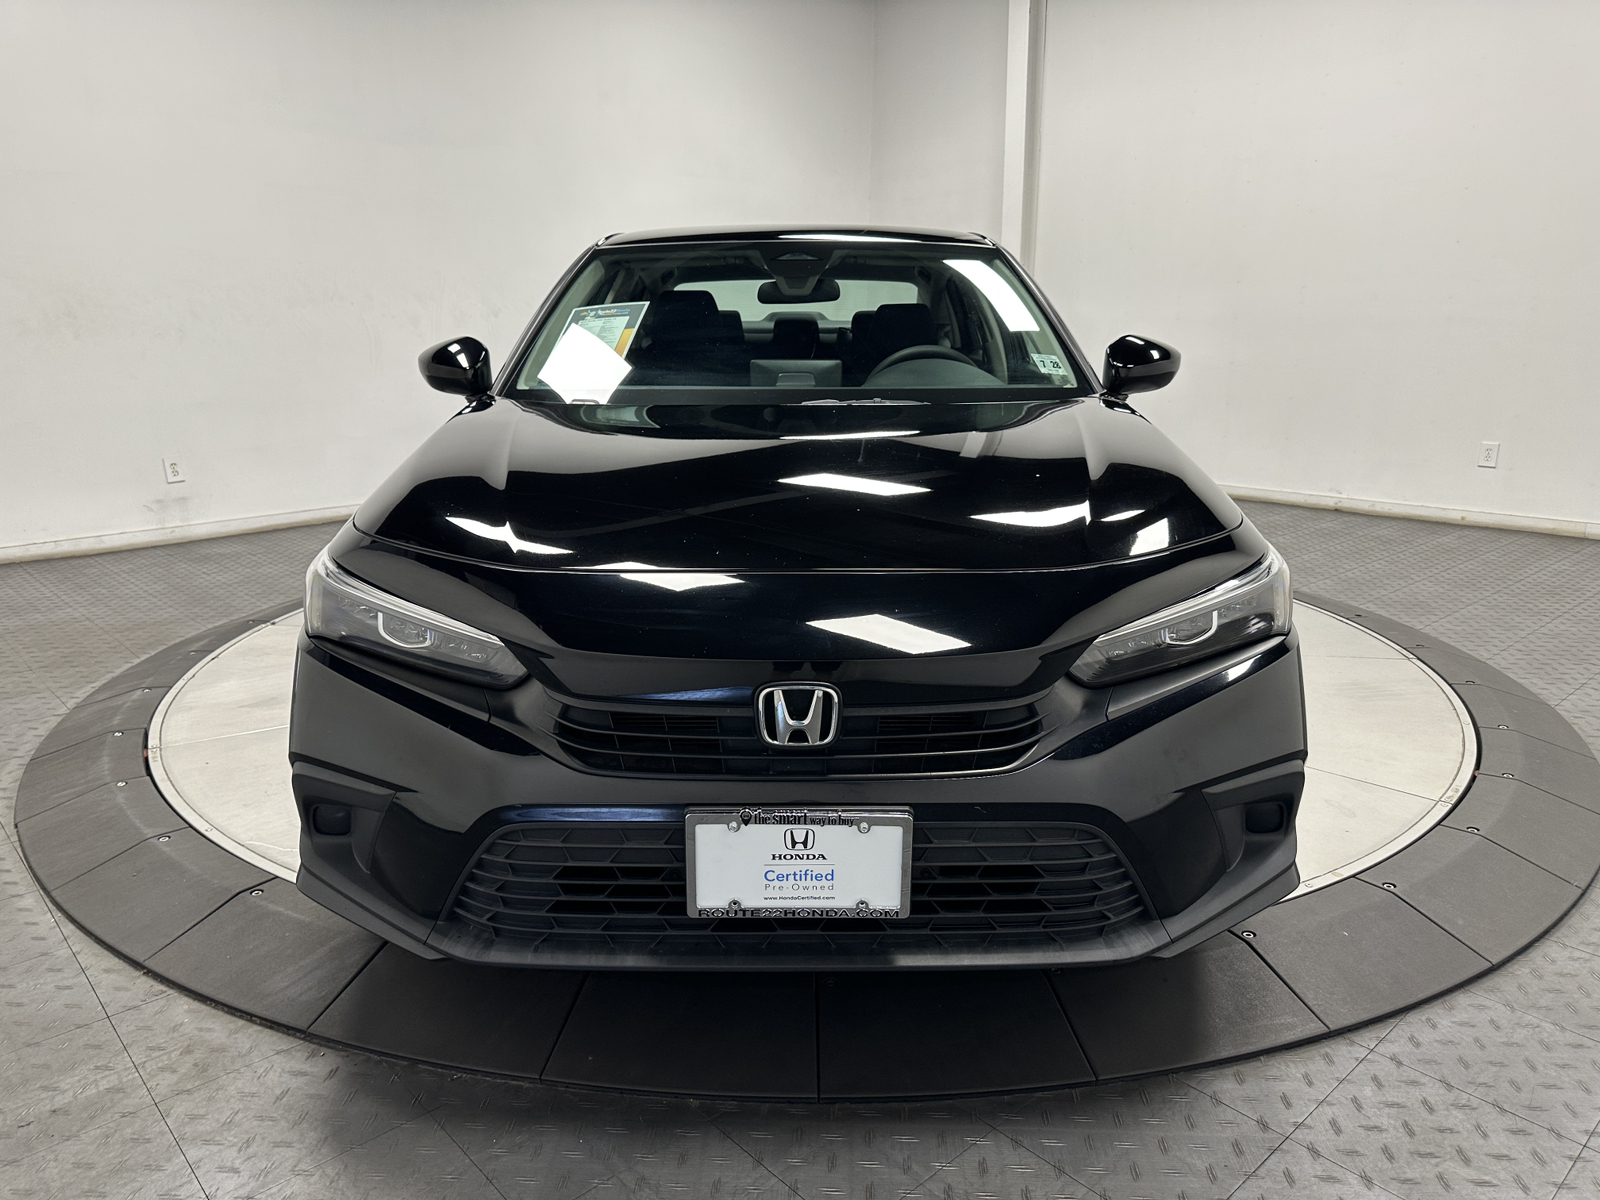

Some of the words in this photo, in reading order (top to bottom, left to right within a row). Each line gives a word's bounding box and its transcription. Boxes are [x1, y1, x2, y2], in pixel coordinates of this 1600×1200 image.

[1040, 360, 1046, 368] 7
[1050, 361, 1061, 369] 28
[754, 810, 771, 825] the
[772, 809, 808, 825] smart
[809, 815, 826, 827] way
[828, 812, 837, 825] to
[838, 811, 855, 827] buy
[771, 853, 827, 861] HONDA
[764, 869, 834, 882] Certified
[764, 883, 834, 891] Pre-Owned
[698, 908, 900, 918] ROUTE22HONDA.COM
